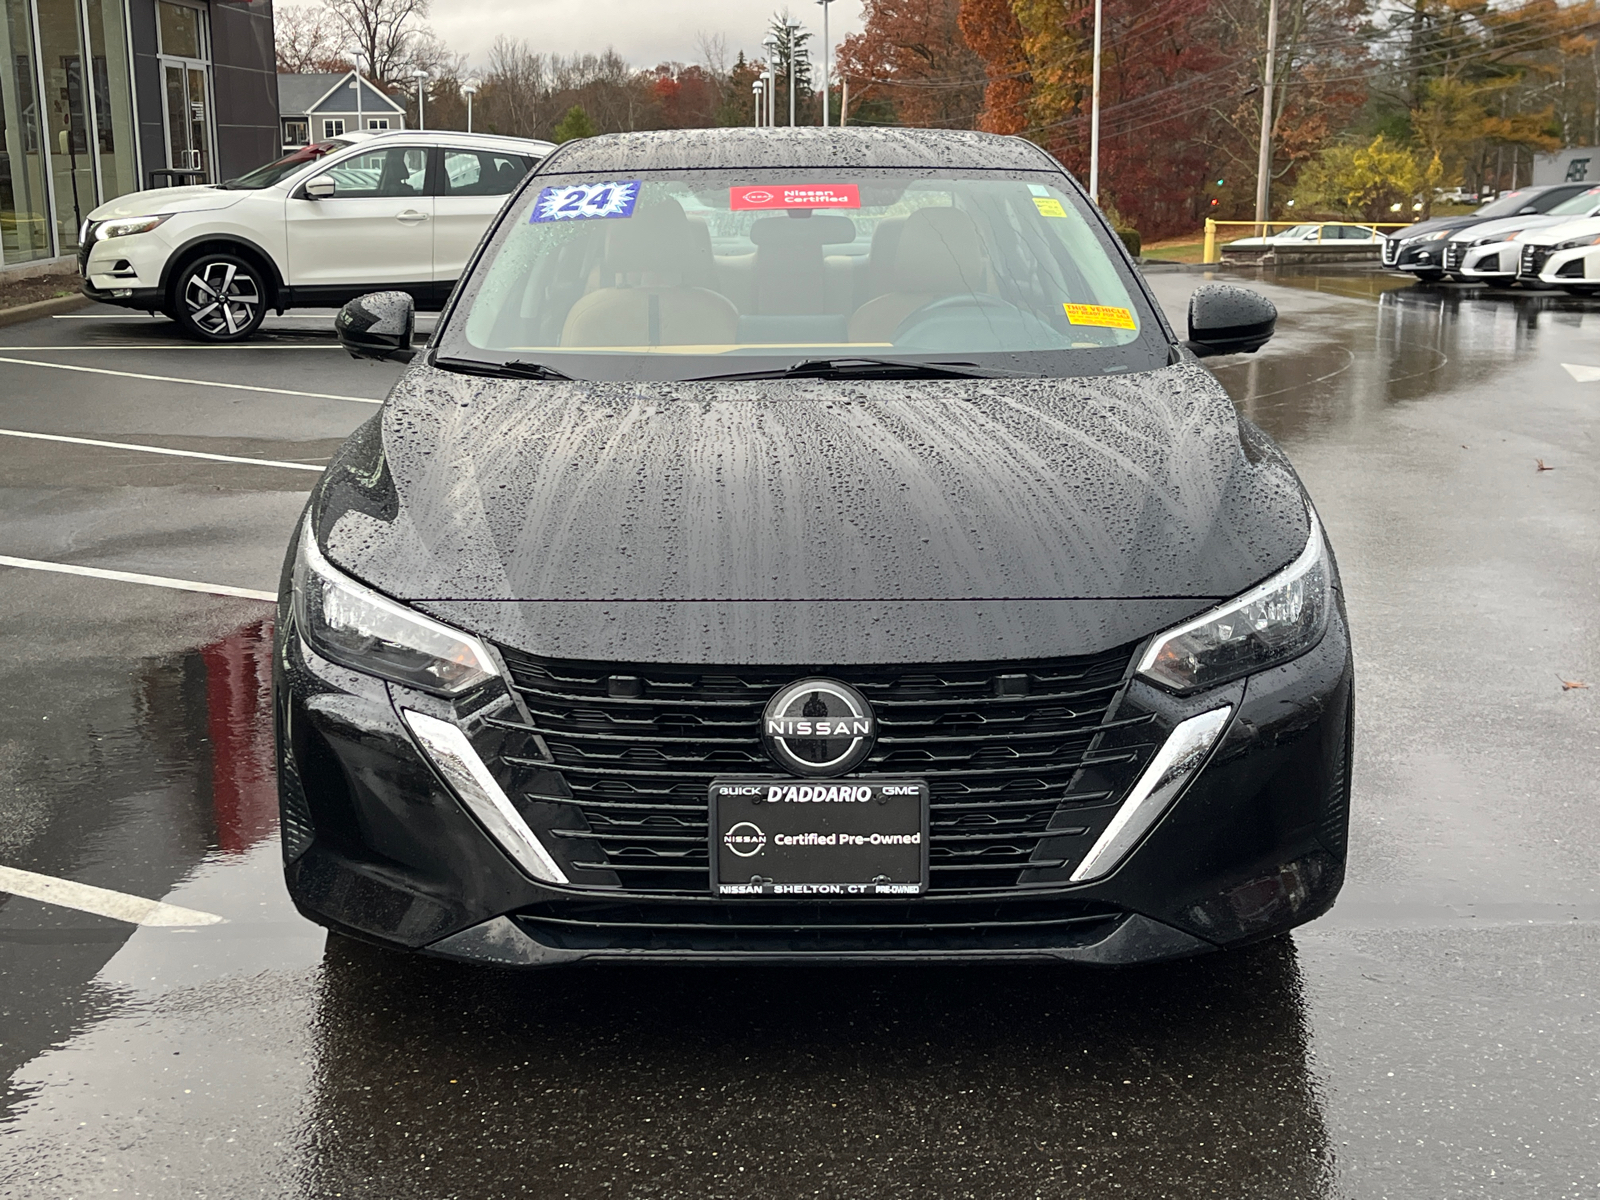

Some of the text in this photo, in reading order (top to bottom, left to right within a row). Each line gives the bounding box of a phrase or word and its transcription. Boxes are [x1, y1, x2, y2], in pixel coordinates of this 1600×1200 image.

[557, 187, 613, 212] 24
[1090, 306, 1127, 314] VEHICLE
[768, 720, 870, 736] NISSAN
[719, 786, 919, 803] BUICK D'ADDARIO GMC
[723, 835, 767, 843] NISSAN
[774, 832, 921, 845] Certified Pre-Owned
[719, 885, 919, 894] NISSAN SHELTON, CT PRE-OWNED
